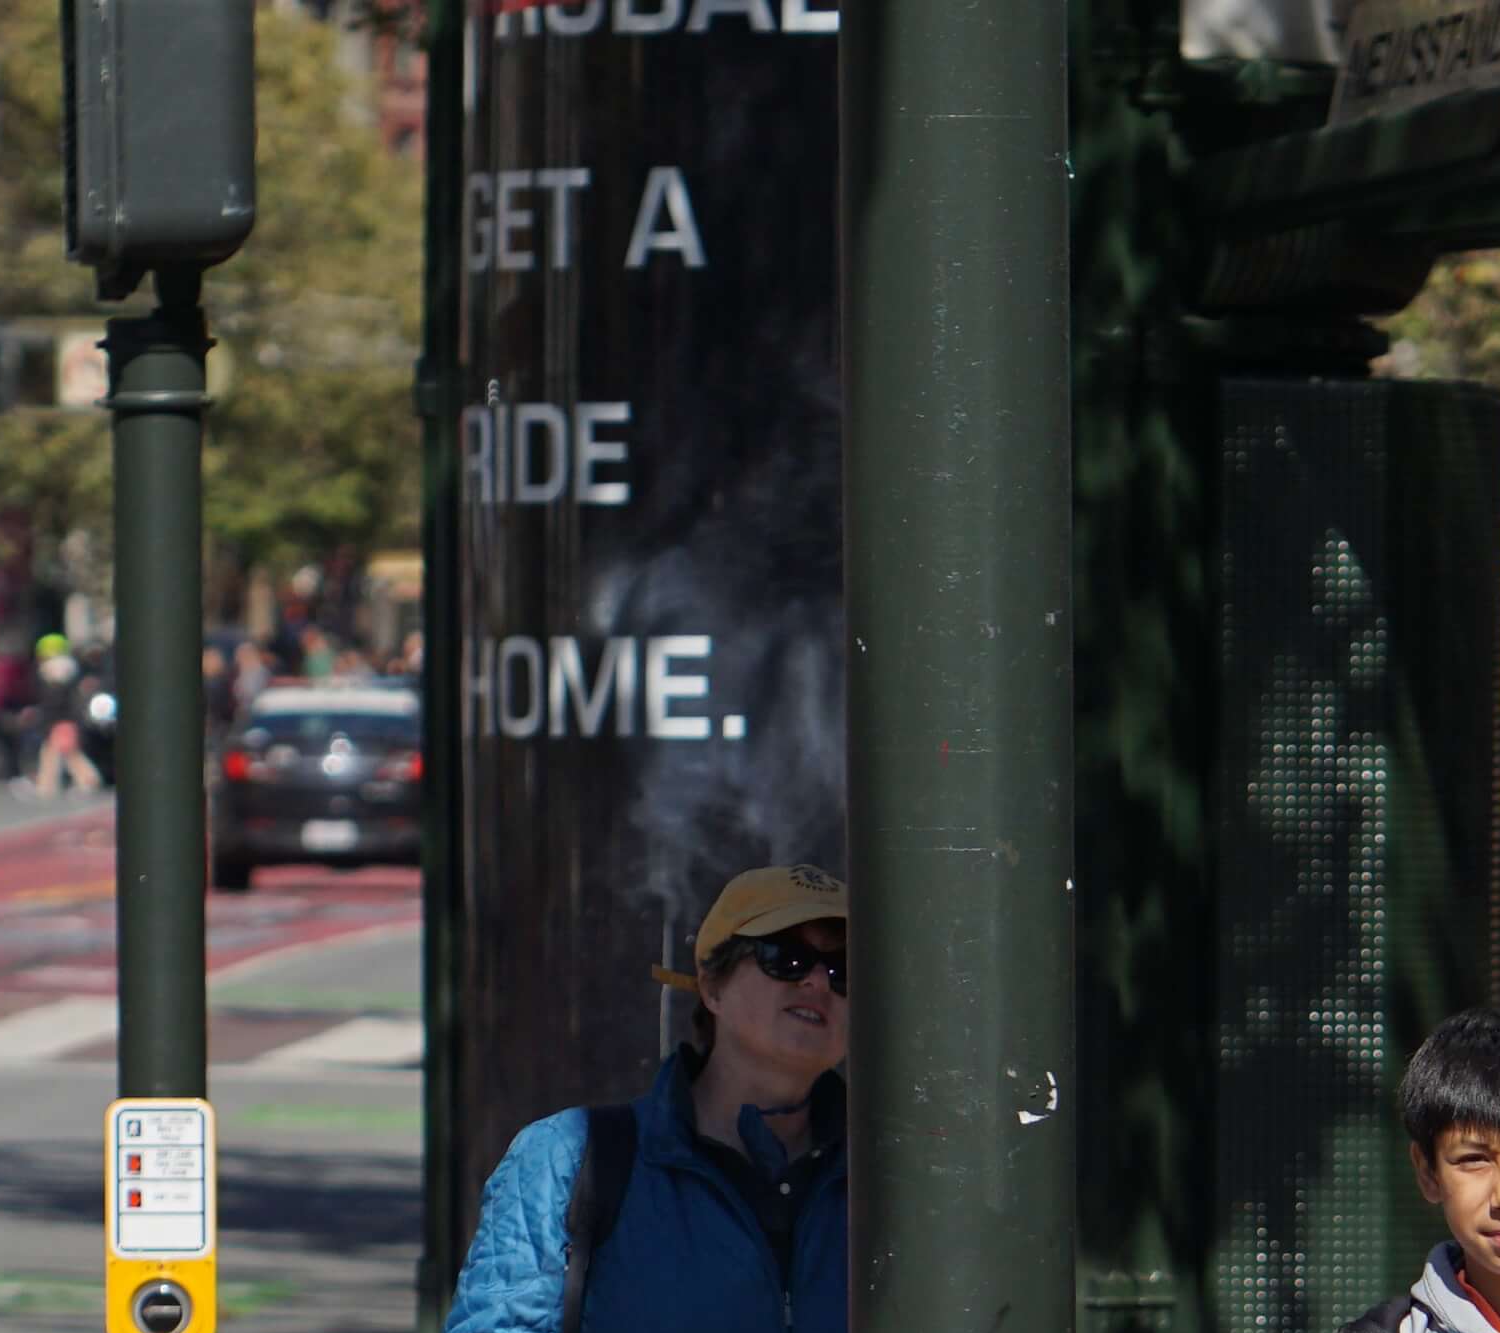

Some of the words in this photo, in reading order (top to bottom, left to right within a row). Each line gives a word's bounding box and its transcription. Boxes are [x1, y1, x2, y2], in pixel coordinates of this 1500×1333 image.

[463, 167, 589, 270] GET
[624, 166, 706, 268] A
[461, 402, 631, 504] RIDE
[461, 635, 746, 739] HOME.
